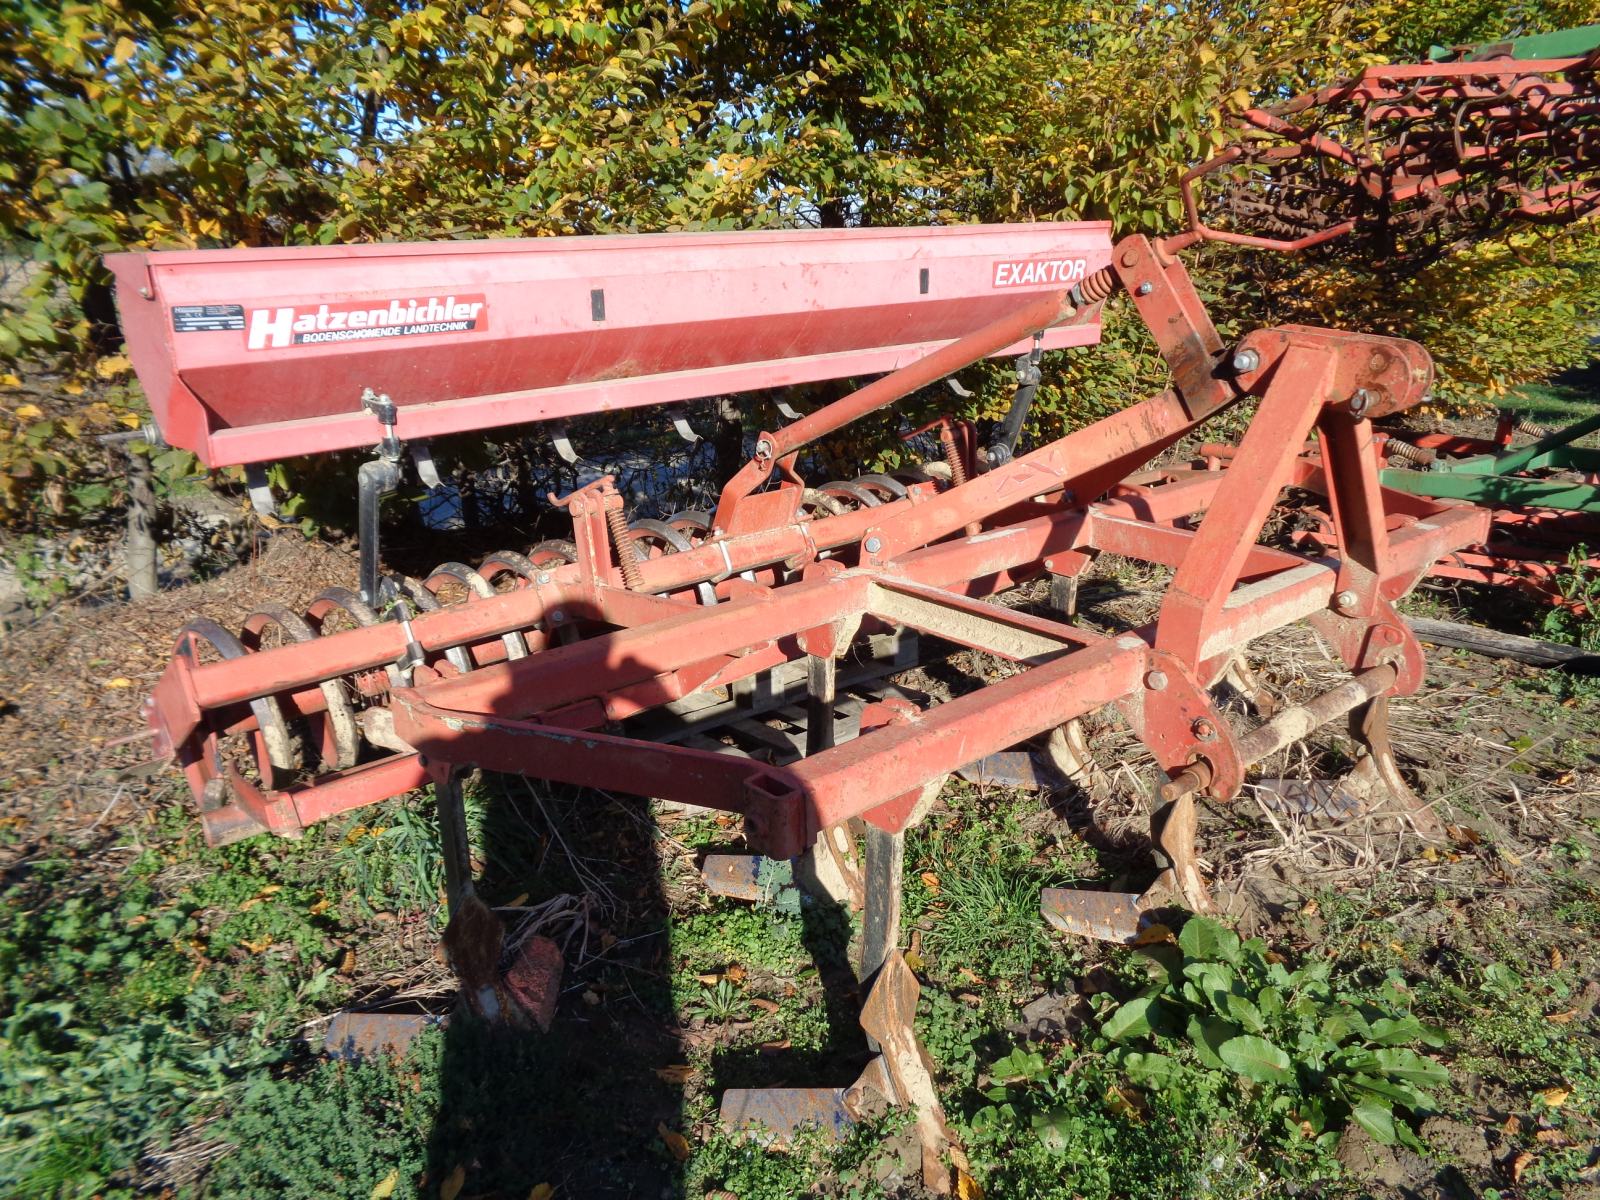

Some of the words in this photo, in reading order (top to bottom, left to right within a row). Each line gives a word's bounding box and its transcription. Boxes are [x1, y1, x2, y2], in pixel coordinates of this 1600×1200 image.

[995, 259, 1086, 285] EXAKTOR
[247, 296, 482, 349] Hatzenbichler
[404, 321, 468, 335] LANDTECHNIK
